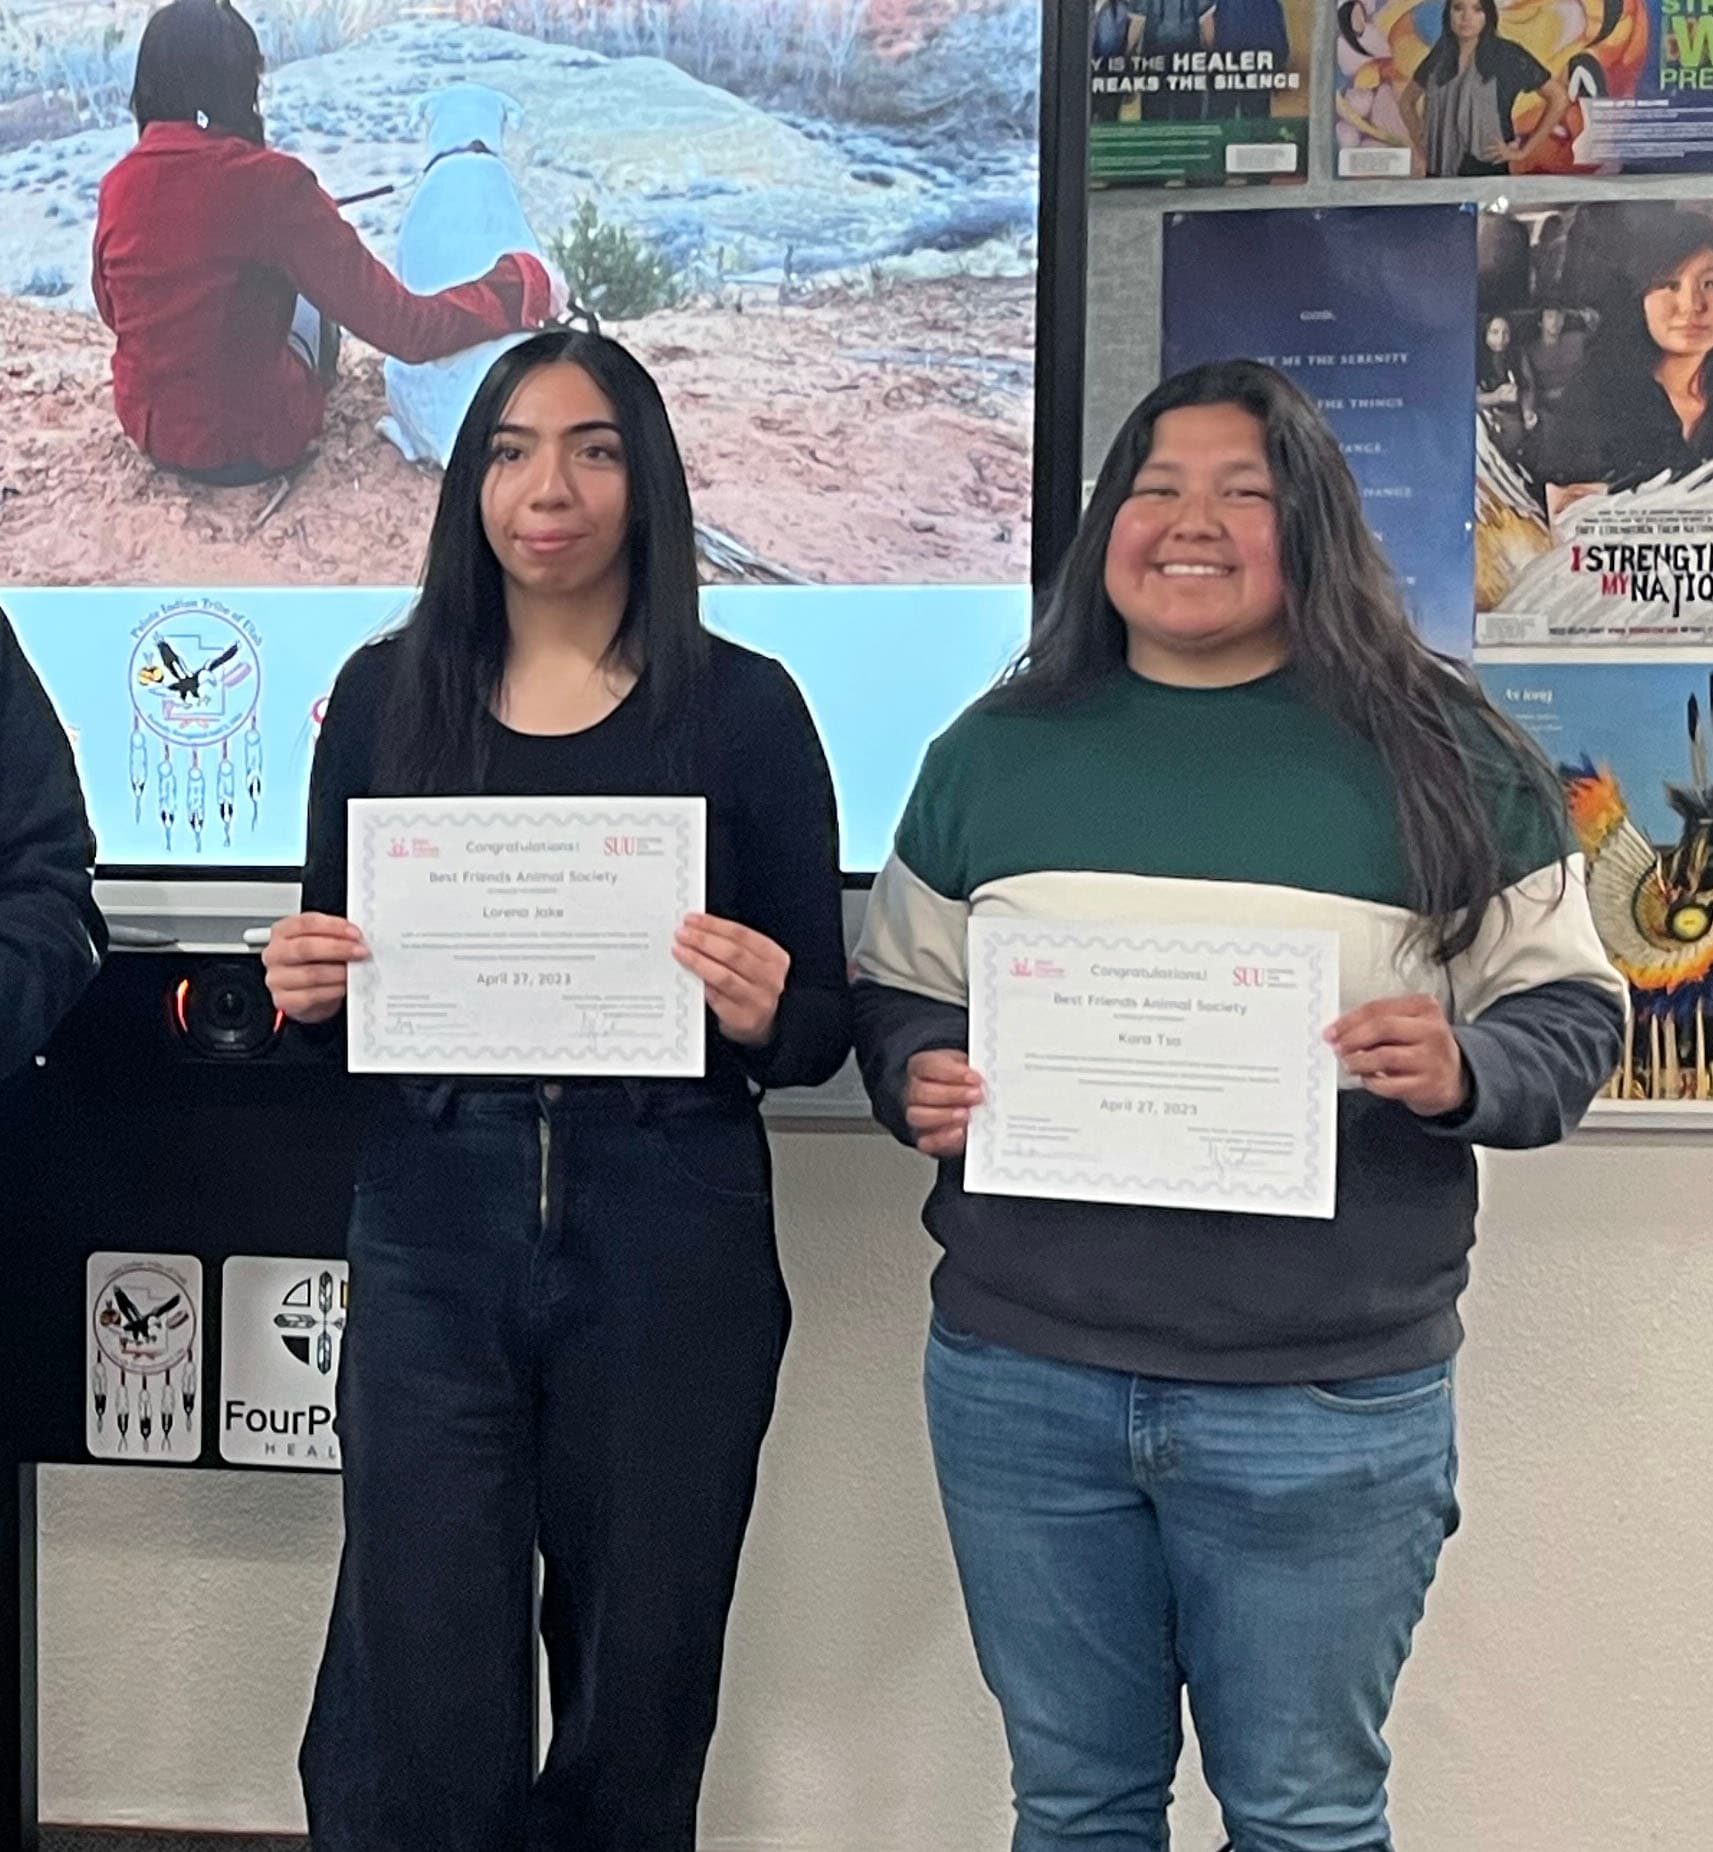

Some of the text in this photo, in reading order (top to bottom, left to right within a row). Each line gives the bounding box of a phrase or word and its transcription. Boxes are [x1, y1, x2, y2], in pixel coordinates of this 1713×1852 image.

[1131, 56, 1166, 72] THE
[1172, 50, 1275, 72] HEALER
[1092, 72, 1301, 93] REAKS THE SILENCE
[1340, 353, 1409, 366] SERENITY
[1601, 572, 1628, 595] MY
[465, 840, 580, 855] Congratulations!
[603, 837, 636, 857] SUU
[429, 870, 618, 884] Best Friends Animal Society
[476, 974, 508, 987] April
[538, 973, 571, 985] 2023
[1090, 964, 1207, 981] Congratulations!
[1232, 966, 1265, 987] SUU
[1053, 993, 1248, 1016] Best Friends Animal Society
[1099, 1099, 1133, 1113] April
[1163, 1103, 1198, 1116] 2023
